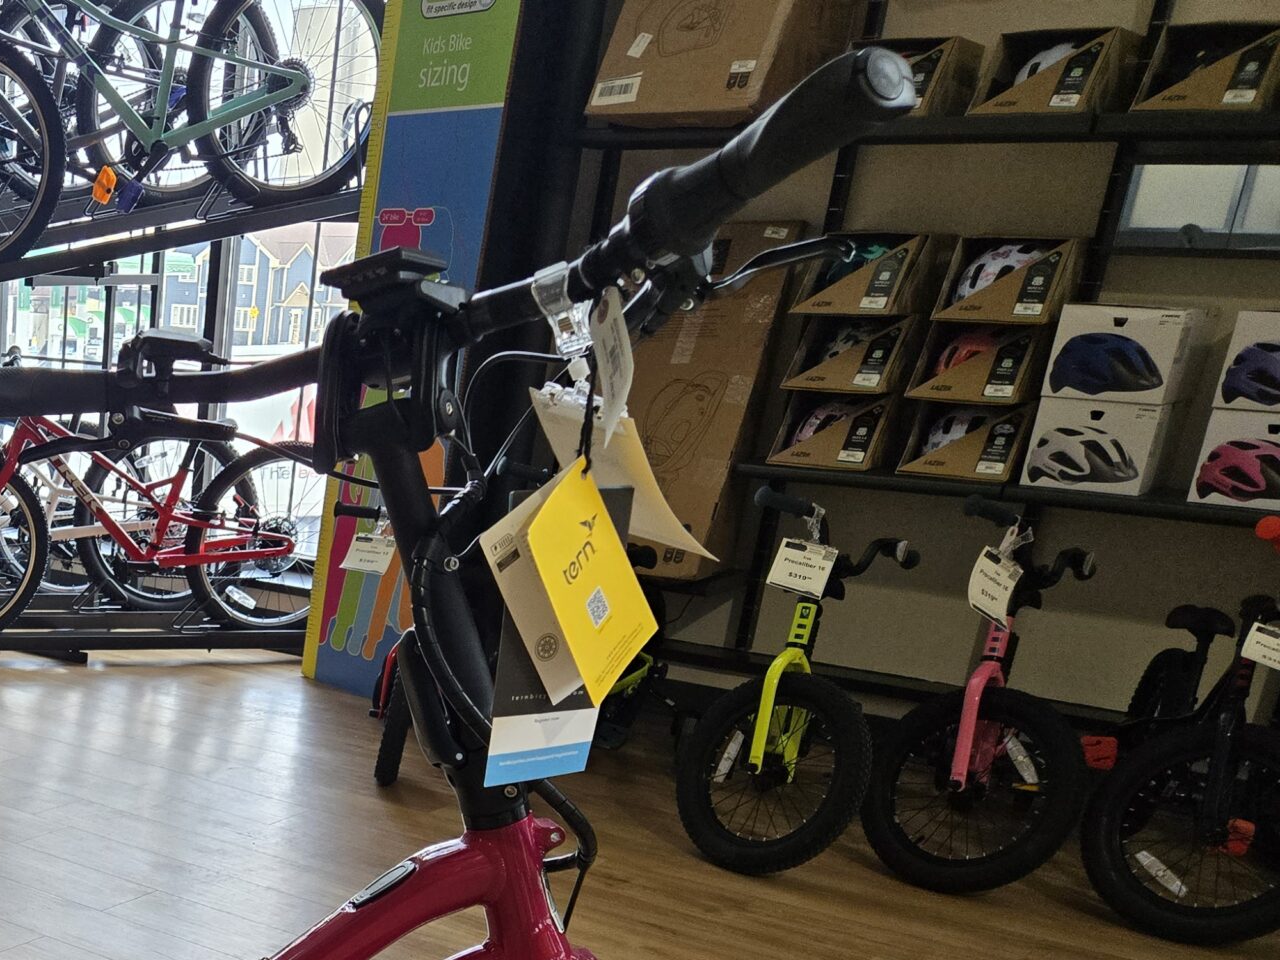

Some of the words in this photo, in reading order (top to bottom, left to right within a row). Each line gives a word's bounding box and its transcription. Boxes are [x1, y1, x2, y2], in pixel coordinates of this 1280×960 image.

[422, 37, 446, 56] Kids
[448, 33, 473, 52] Bike
[418, 60, 470, 92] sizing
[562, 540, 596, 585] tern
[783, 557, 817, 569] Precaliber
[979, 568, 1002, 587] Precaliber
